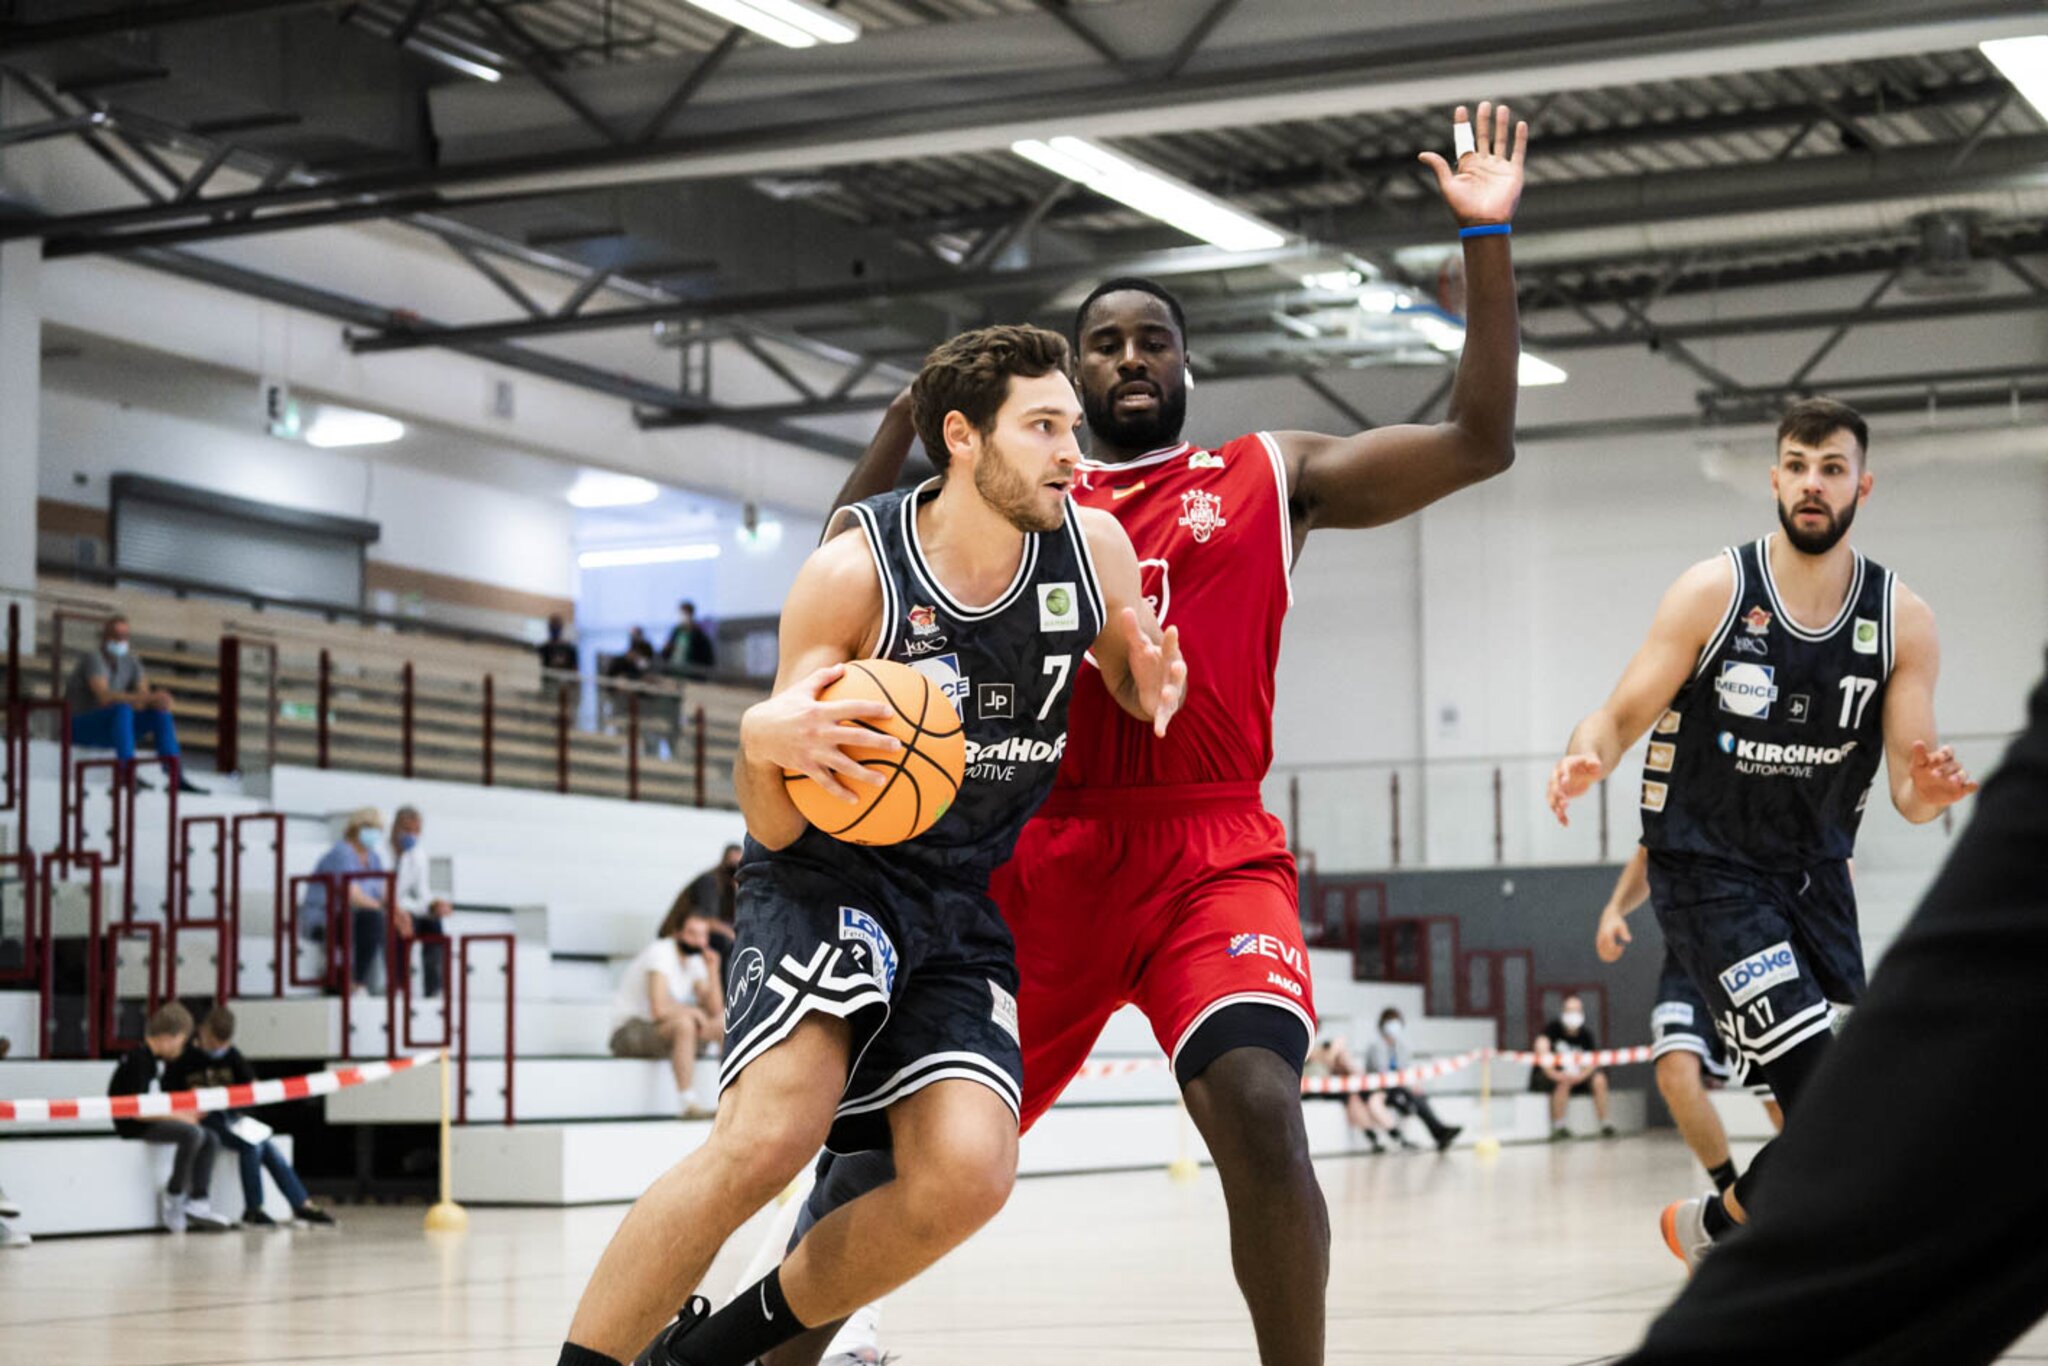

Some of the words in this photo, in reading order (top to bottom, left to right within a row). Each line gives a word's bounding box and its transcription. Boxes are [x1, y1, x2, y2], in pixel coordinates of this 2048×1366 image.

[1037, 654, 1072, 721] 7
[1715, 680, 1778, 699] MEDICE
[1838, 675, 1878, 729] 17
[1259, 934, 1308, 978] EVL
[1722, 950, 1793, 994] Löbke
[1267, 971, 1303, 997] JAKO
[1748, 996, 1775, 1029] 17
